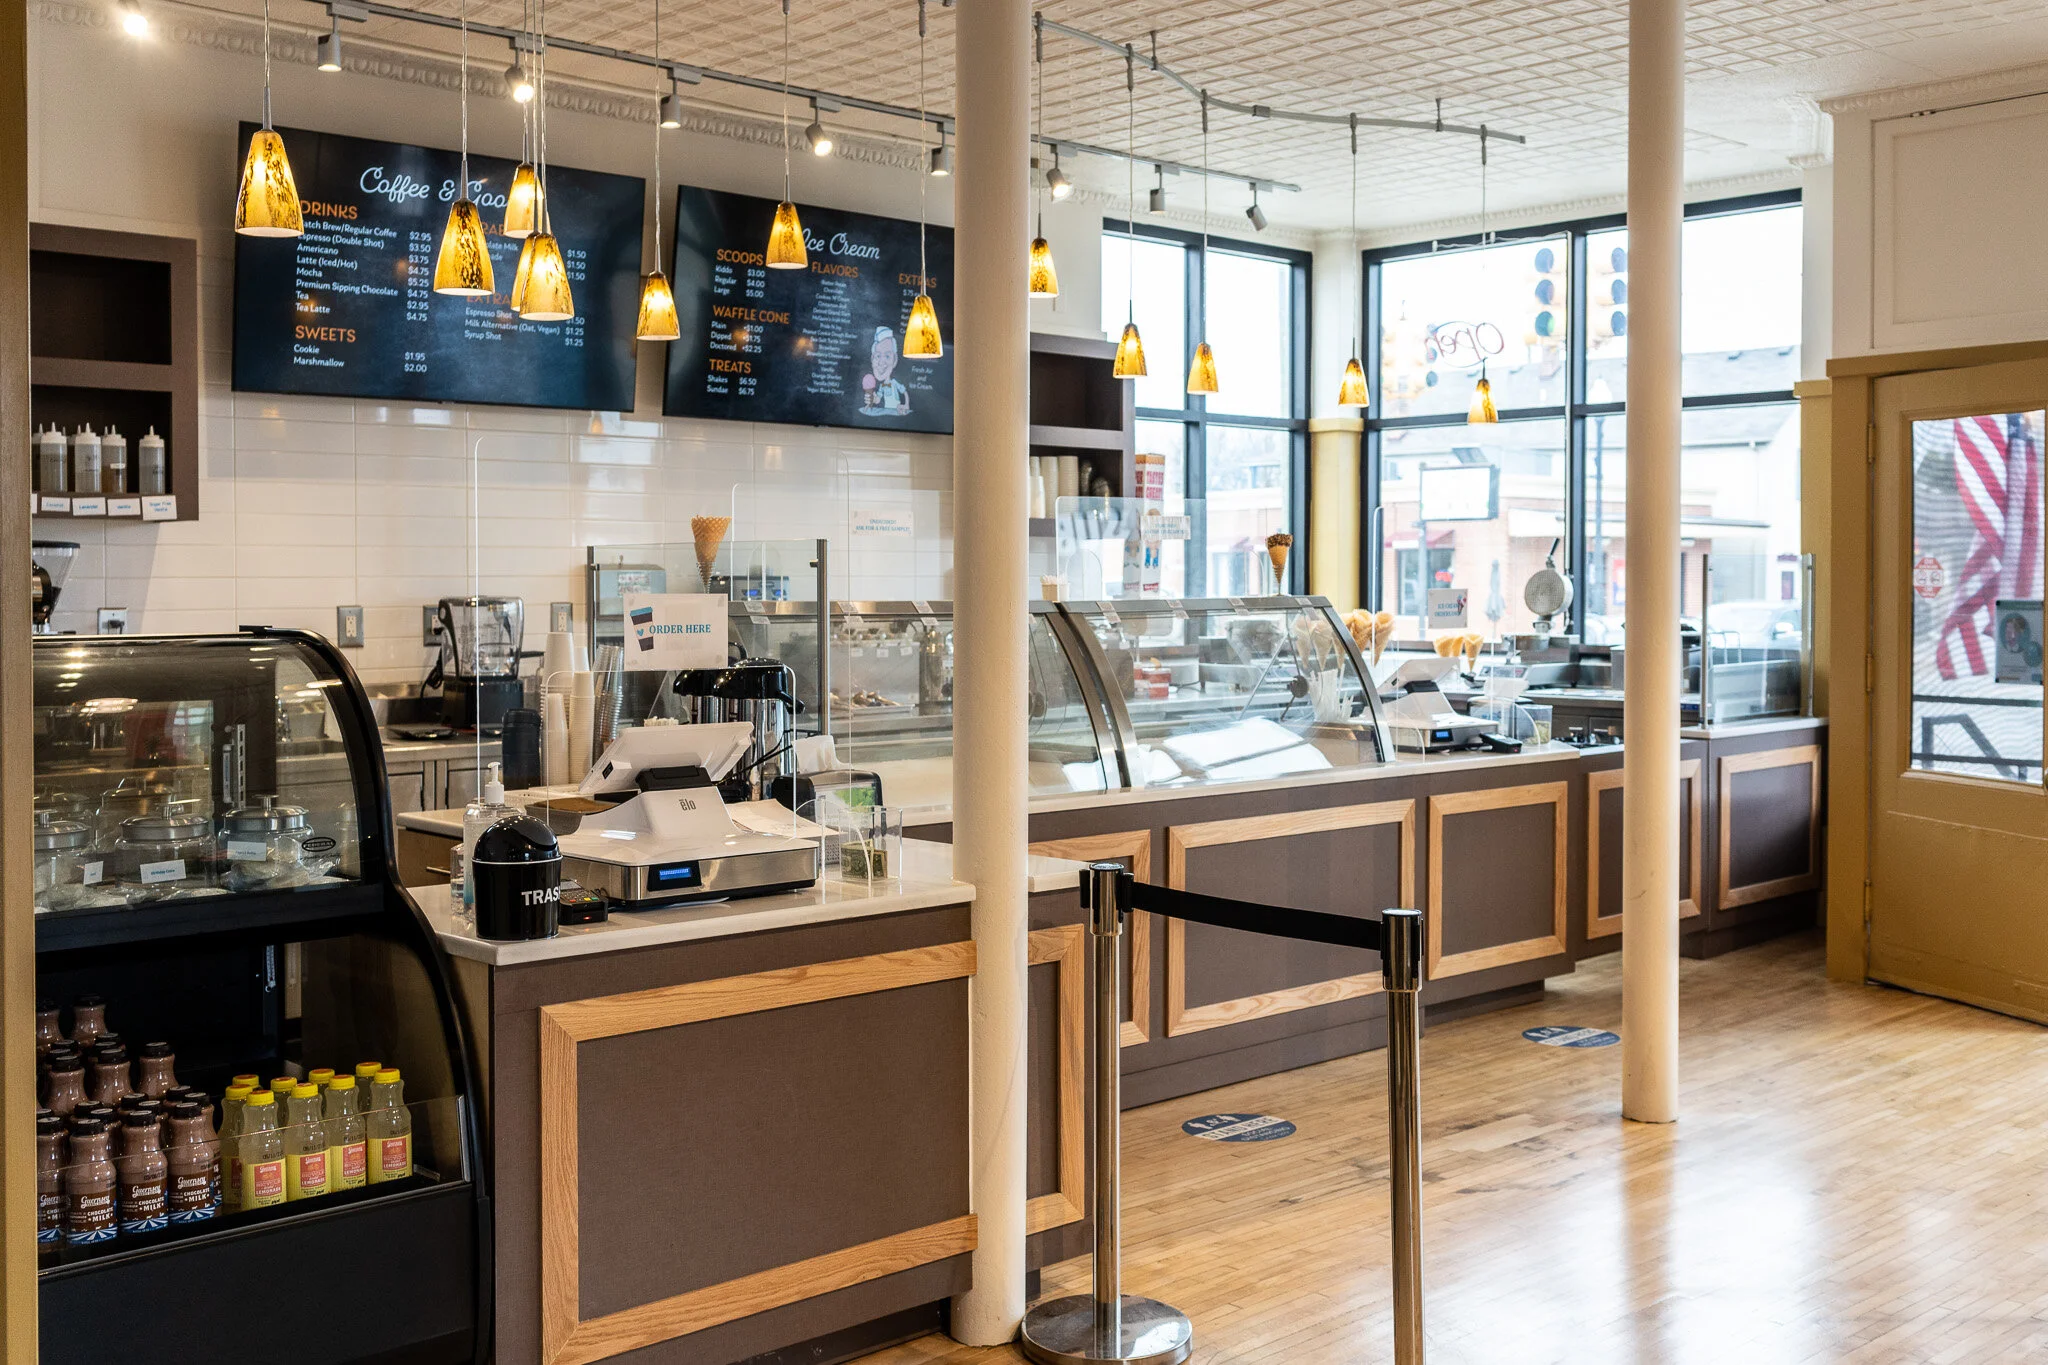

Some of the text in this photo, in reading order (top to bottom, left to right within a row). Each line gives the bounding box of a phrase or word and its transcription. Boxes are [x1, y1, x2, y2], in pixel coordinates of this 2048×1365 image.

[360, 167, 430, 203] Coffee
[438, 179, 456, 201] &
[300, 200, 358, 220] DRINKS
[302, 221, 398, 238] atch Brew/Regular Coffee
[409, 231, 431, 241] $2.95
[332, 234, 362, 246] (Double
[363, 238, 385, 249] Shot)
[802, 228, 880, 260] Ice Cream
[297, 243, 339, 255] Americano
[408, 243, 431, 253] $3.50
[408, 254, 429, 264] $3.75
[567, 249, 587, 259] $1.50
[716, 249, 764, 266] SCOOPS
[296, 256, 358, 270] Latte (Iced/Hot)
[567, 260, 586, 270] $1.50
[296, 266, 323, 277] Mocha
[407, 266, 429, 275] $4.75
[747, 268, 765, 278] $3.00
[811, 261, 859, 279] FLAVORS
[407, 277, 430, 287] $5.25
[714, 275, 737, 286] Regular
[746, 278, 765, 288] $4.00
[296, 279, 399, 296] Premium Sipping Chocolate
[713, 286, 731, 296] Large
[295, 290, 309, 300] Tea
[407, 288, 428, 298] $4.75
[745, 289, 764, 298] $5.00
[295, 302, 331, 314] Tea Latte
[406, 300, 429, 310] $2.95
[406, 312, 428, 321] $4.75
[465, 307, 495, 318] Espresso
[712, 305, 790, 324] WAFFLE CONE
[465, 318, 480, 328] Milk
[481, 320, 518, 331] Alternative
[538, 325, 561, 336] Vegan)
[711, 320, 727, 330] Plain
[295, 325, 356, 343] SWEETS
[464, 329, 501, 340] Syrup Shot
[565, 327, 584, 336] $1.25
[710, 331, 732, 342] Dipped
[564, 338, 584, 347] $1.25
[709, 341, 737, 352] Doctored
[293, 344, 320, 354] Cookie
[404, 352, 426, 361] $1.95
[293, 356, 345, 368] Marshmallow
[709, 359, 751, 374] TREATS
[404, 363, 427, 373] $2.00
[707, 374, 728, 384] Shakes
[649, 624, 712, 635] ORDER HERE
[521, 886, 560, 906] TRAS
[183, 1187, 210, 1197] CHOCOLATE
[138, 1196, 165, 1206] CHOCOLATE
[188, 1193, 206, 1203] MILK
[87, 1206, 114, 1217] CHOCOLATE
[143, 1202, 161, 1212] MILK
[92, 1212, 110, 1222] MILK
